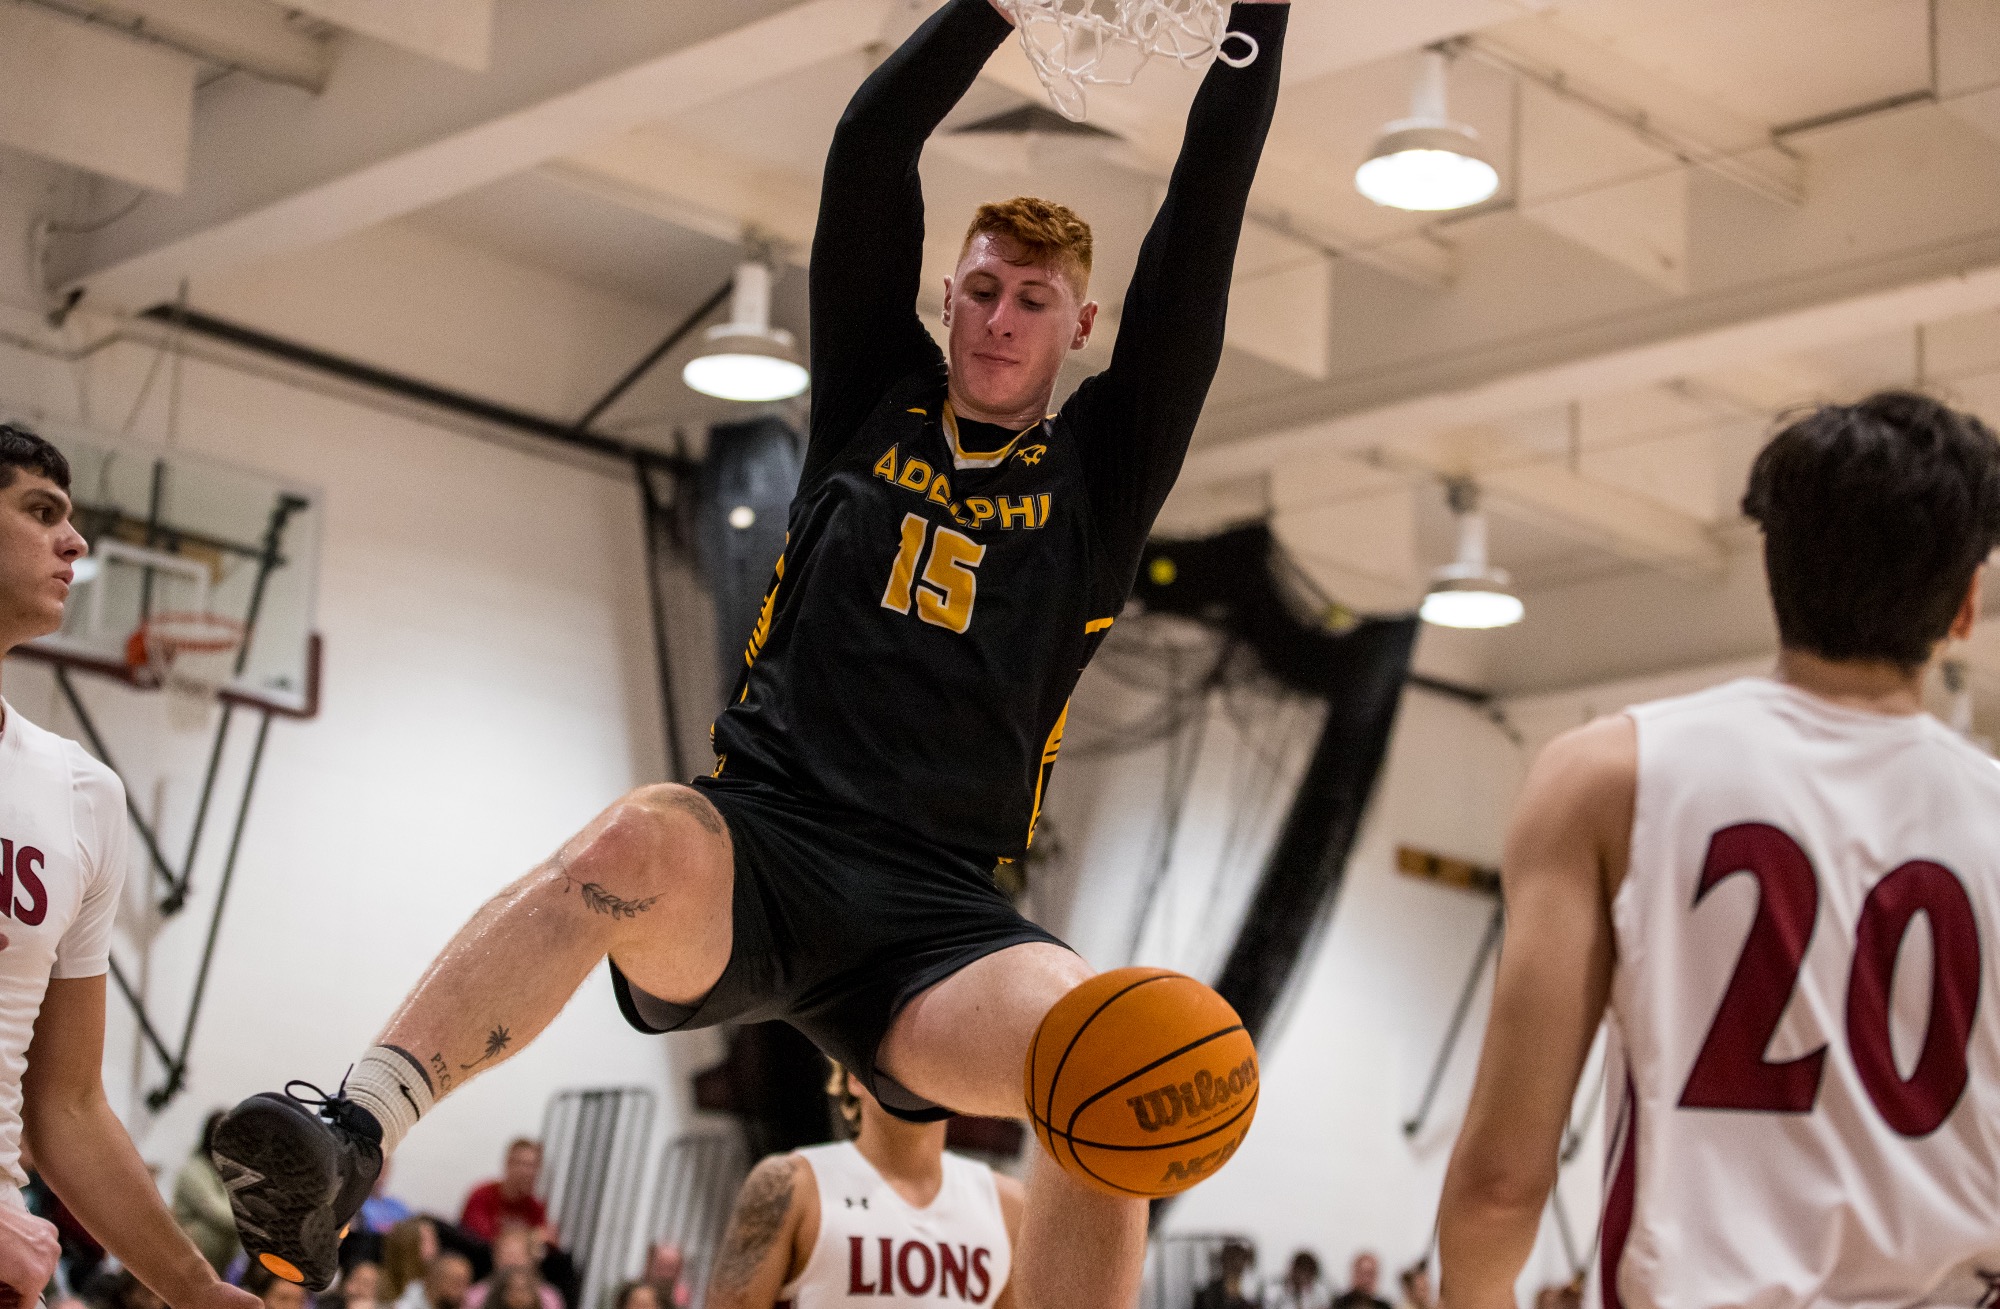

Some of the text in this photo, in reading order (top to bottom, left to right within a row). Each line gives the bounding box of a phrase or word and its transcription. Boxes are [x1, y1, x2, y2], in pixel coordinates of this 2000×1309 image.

[880, 511, 986, 634] 15
[1677, 821, 1981, 1139] 20
[1126, 1056, 1257, 1132] Wilson
[847, 1236, 991, 1304] LIONS
